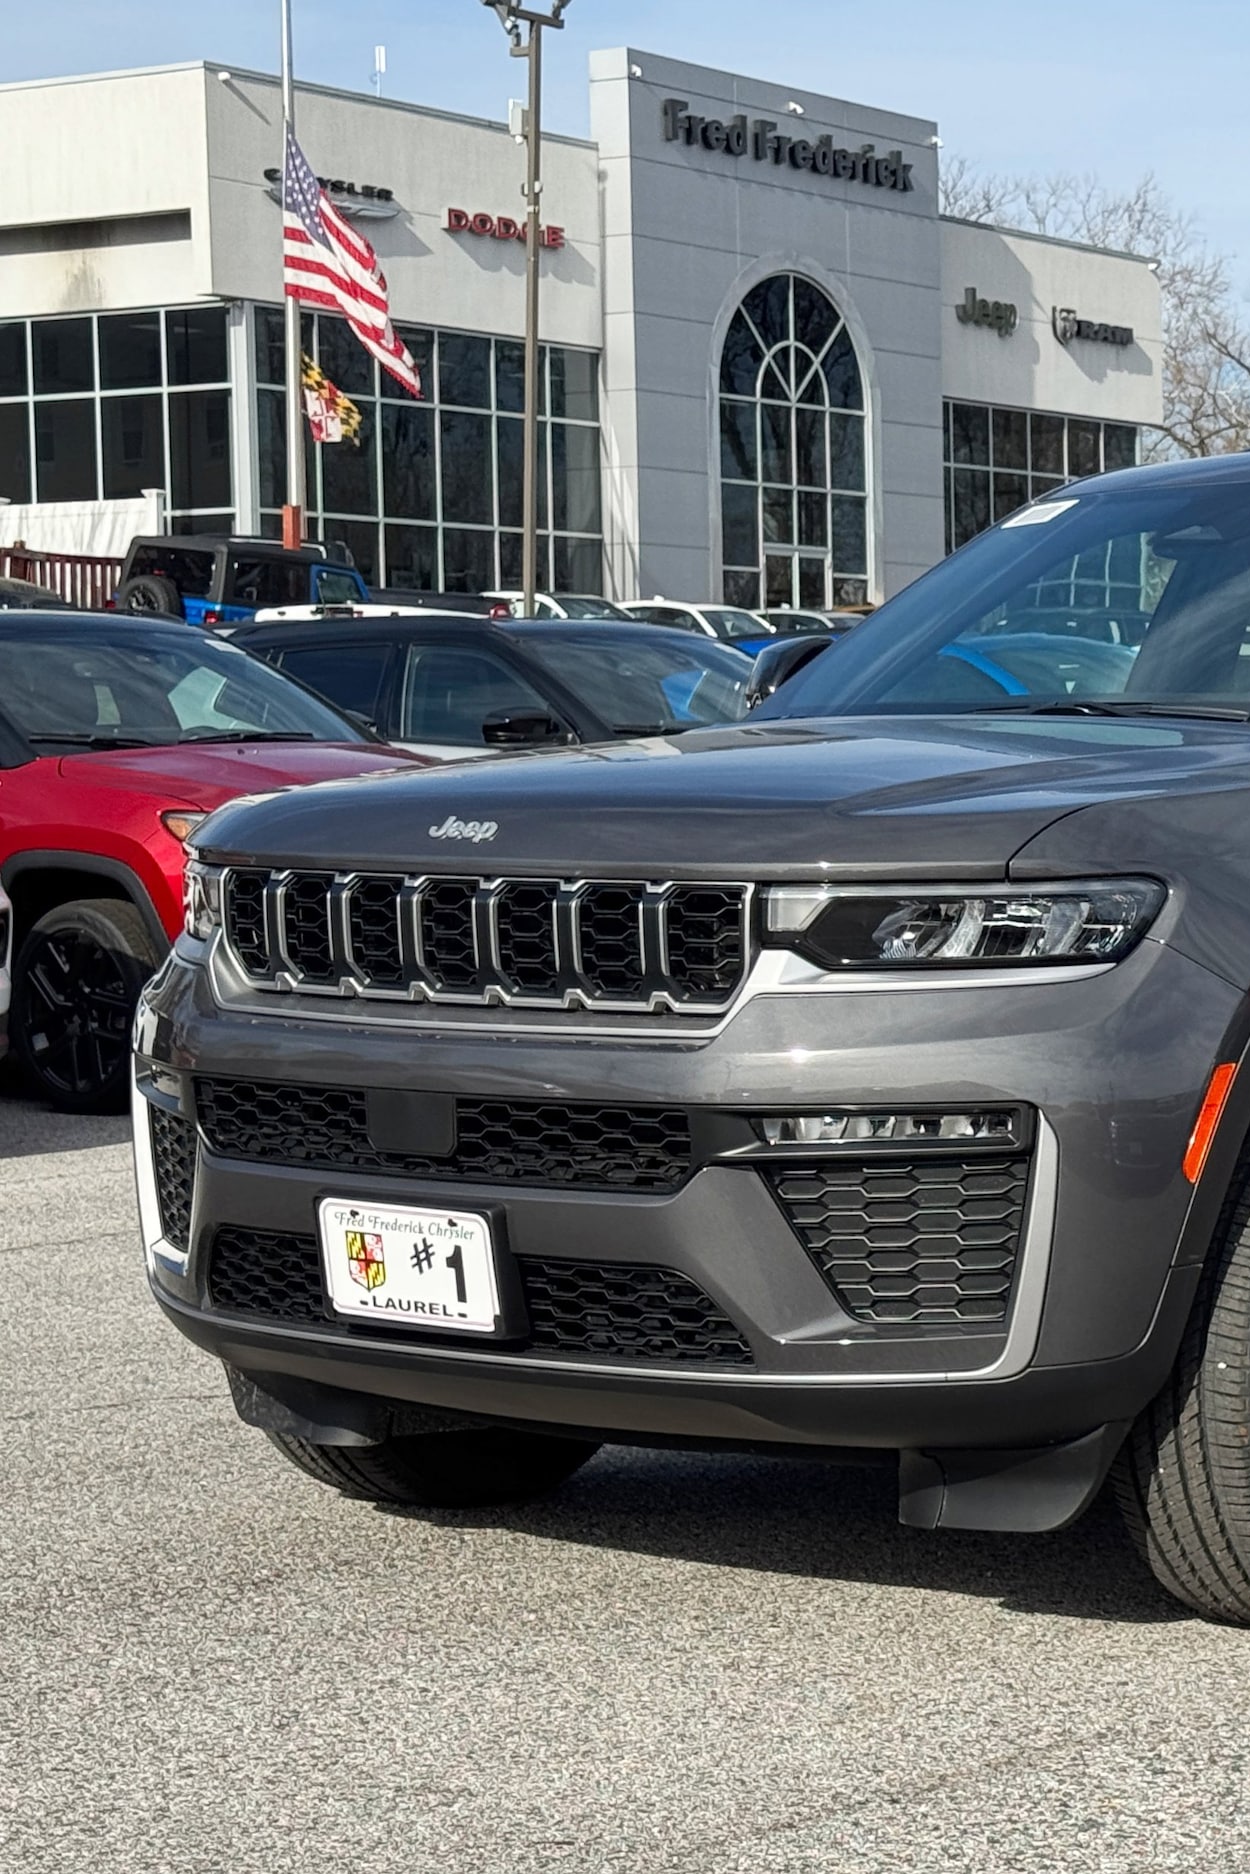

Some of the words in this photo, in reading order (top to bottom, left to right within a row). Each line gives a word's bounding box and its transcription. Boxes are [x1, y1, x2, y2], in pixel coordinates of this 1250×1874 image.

[664, 98, 747, 156] Fred
[752, 119, 914, 192] Frederick
[955, 287, 1017, 338] Jeep
[1077, 320, 1134, 345] RAM
[428, 815, 499, 843] Jeep
[334, 1211, 365, 1228] Fred
[368, 1216, 424, 1234] Frederick
[428, 1222, 475, 1241] Chrysler
